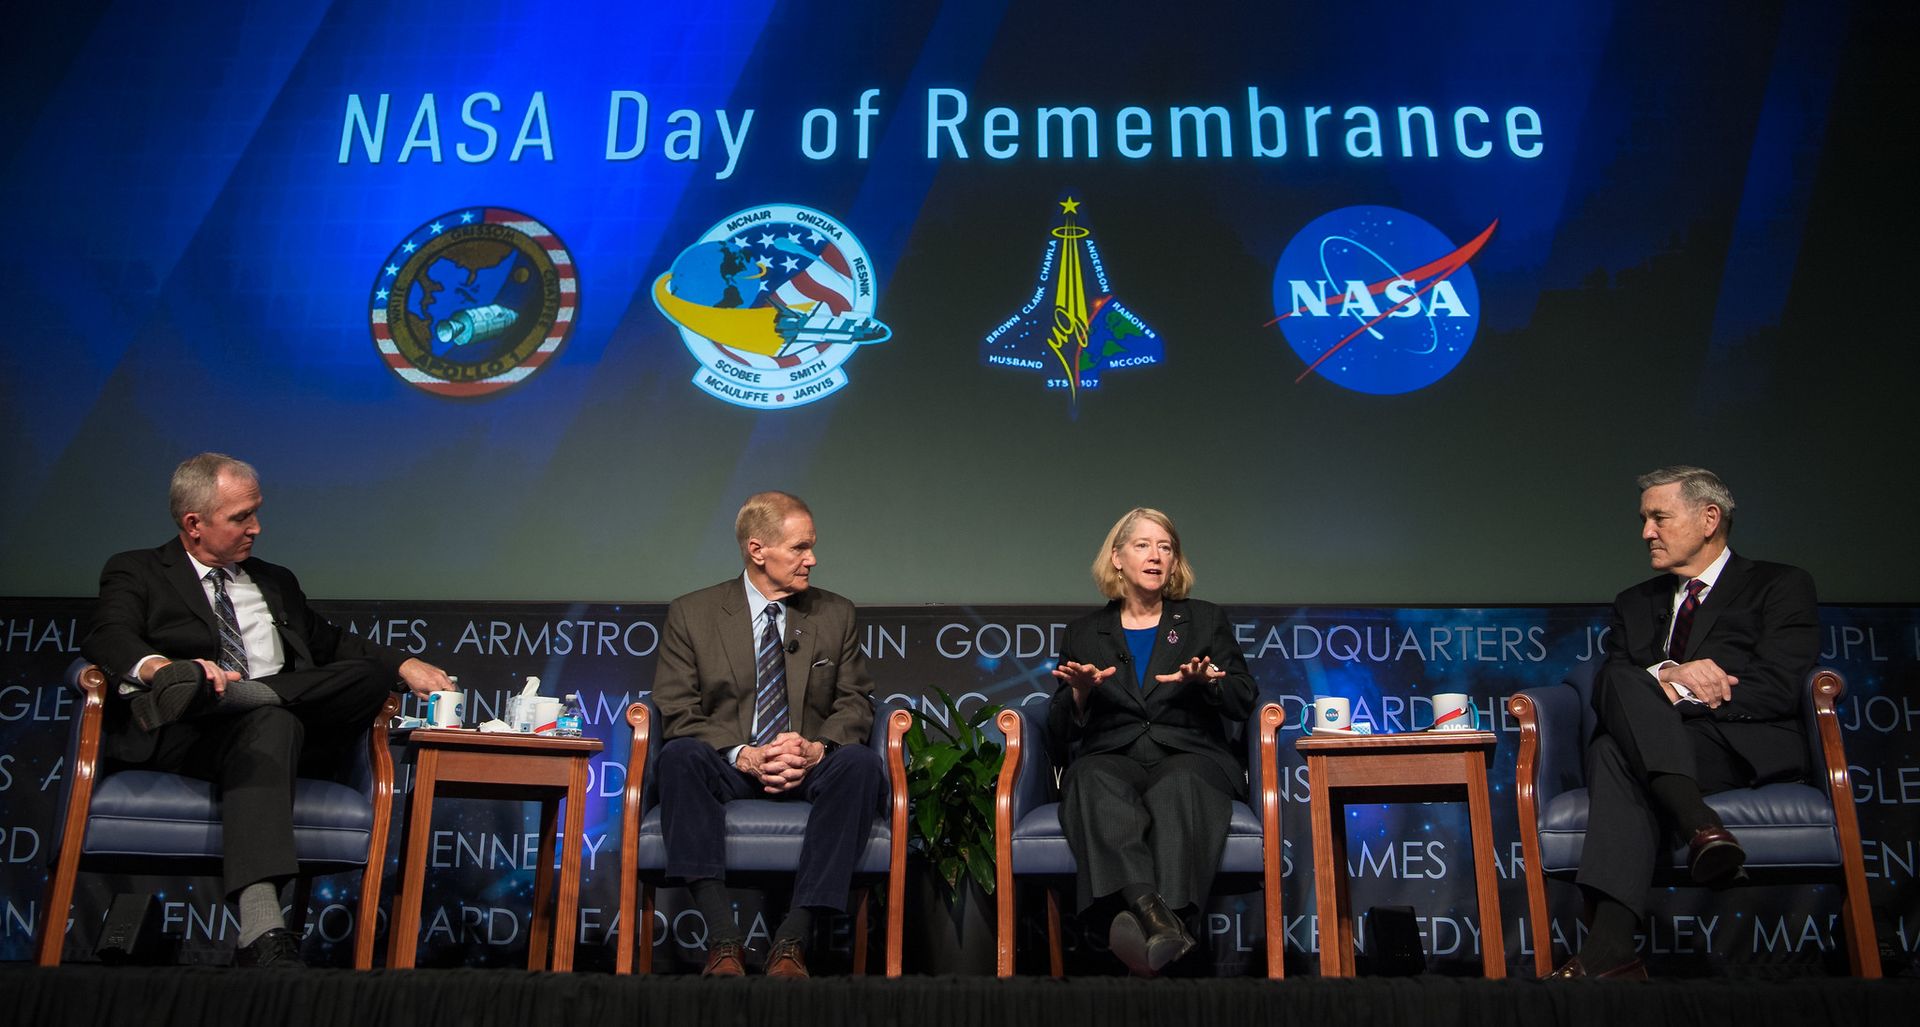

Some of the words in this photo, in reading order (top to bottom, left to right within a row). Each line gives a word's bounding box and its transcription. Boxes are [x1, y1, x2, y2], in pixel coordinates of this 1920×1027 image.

[338, 90, 556, 164] NASA
[604, 89, 755, 180] Day
[801, 88, 880, 160] of
[926, 86, 1545, 159] Remembrance
[451, 225, 516, 242] GRISSOM
[726, 210, 771, 232] MCNAIR
[796, 211, 843, 240] ONIZUKA
[853, 257, 870, 297] RESNIK
[1085, 239, 1110, 293] ANDERSON
[1112, 301, 1146, 334] RAMON
[390, 285, 405, 323] WHITE
[985, 314, 1021, 344] BROWN
[1022, 286, 1045, 315] CLARK
[1040, 239, 1057, 281] CHAWLA
[1288, 279, 1471, 319] NASA
[415, 353, 504, 380] APOLLO
[715, 359, 761, 383] SCOBEE
[789, 360, 827, 382] SMITH
[989, 355, 1044, 369] HUSBAND
[1109, 355, 1157, 369] MCCOOL
[704, 375, 769, 402] MCAULIFFE
[793, 377, 834, 400] JARVIS
[1047, 379, 1069, 387] STS
[1080, 379, 1099, 387] 107
[1821, 625, 1888, 661] JPL
